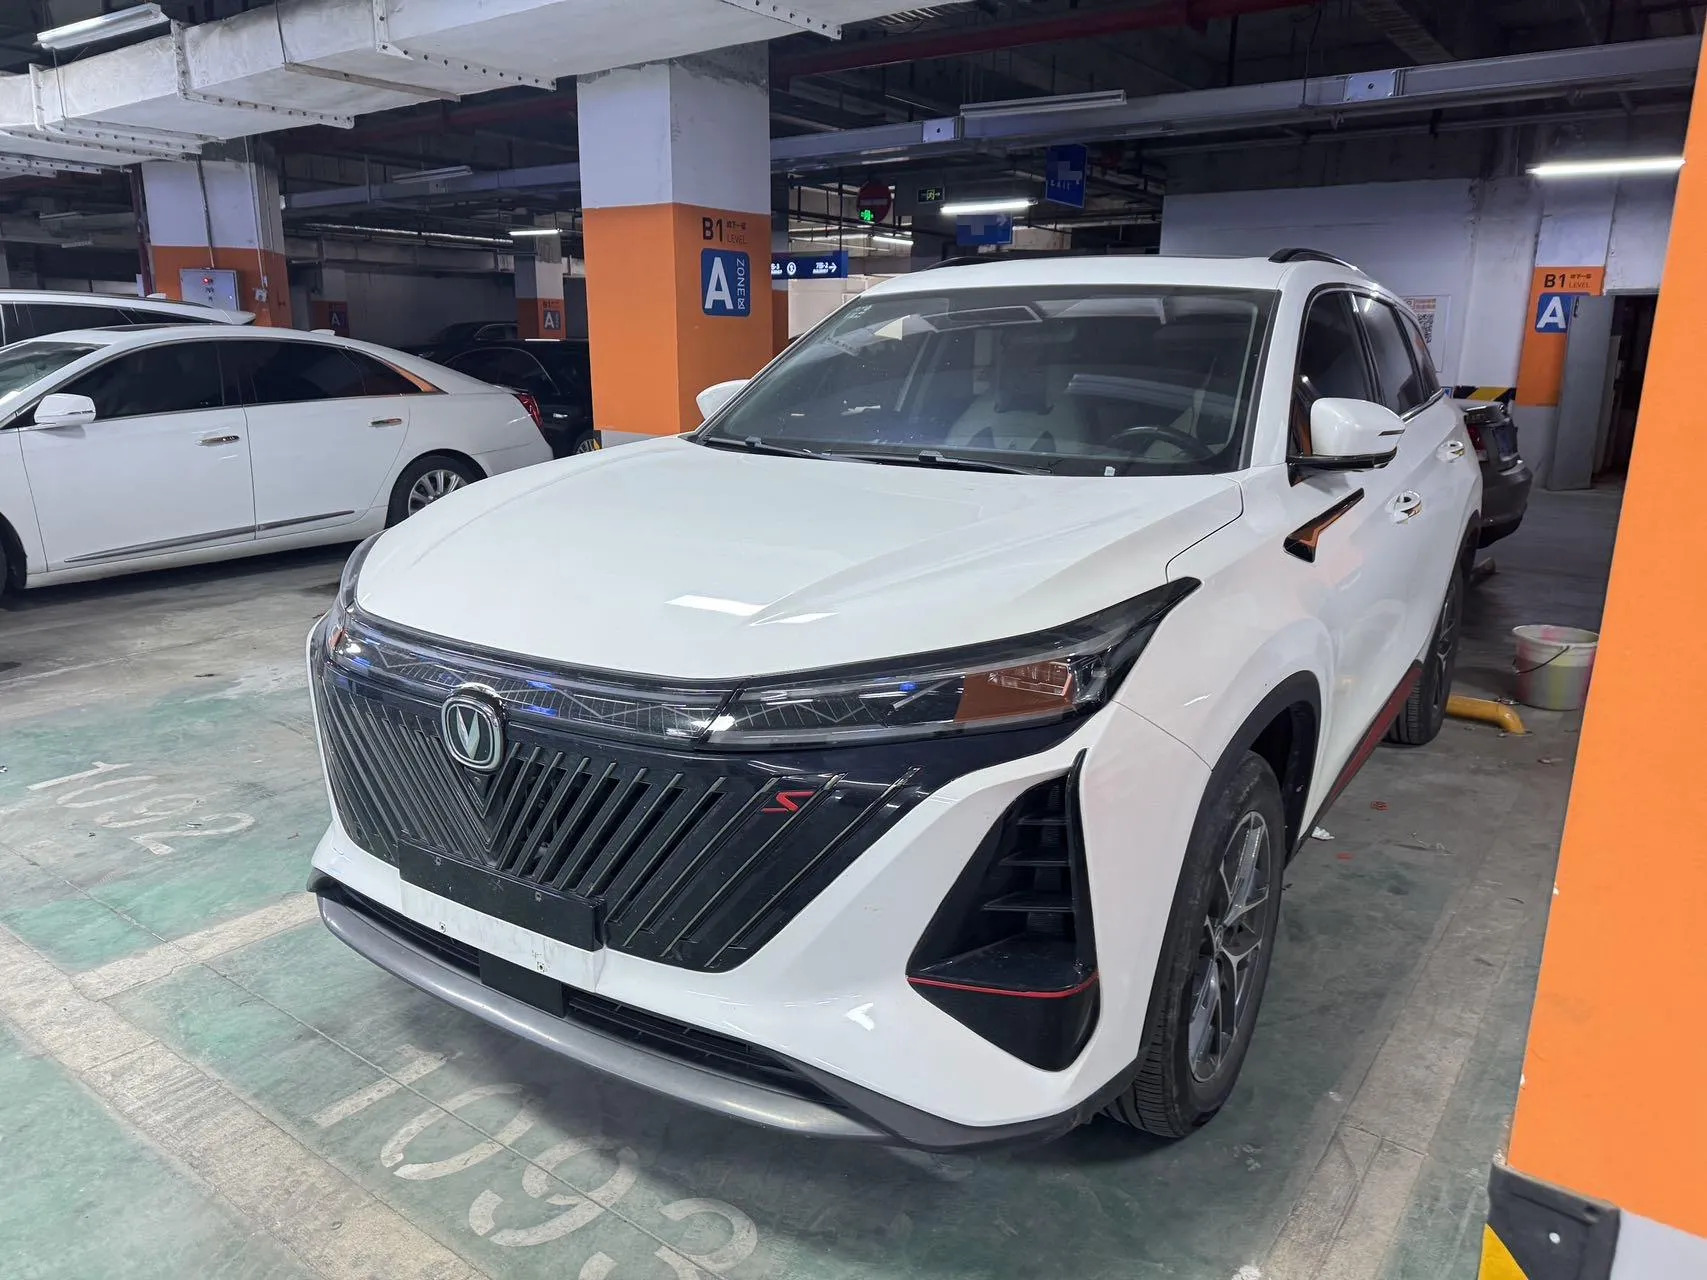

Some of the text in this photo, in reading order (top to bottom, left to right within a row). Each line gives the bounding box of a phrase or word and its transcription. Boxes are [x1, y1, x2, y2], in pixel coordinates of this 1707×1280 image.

[702, 217, 723, 242] B1
[727, 233, 749, 245] LEVEL
[704, 257, 733, 309] A
[1544, 273, 1567, 288] B1
[331, 312, 340, 326] A
[544, 311, 555, 328] A
[1537, 296, 1566, 328] A
